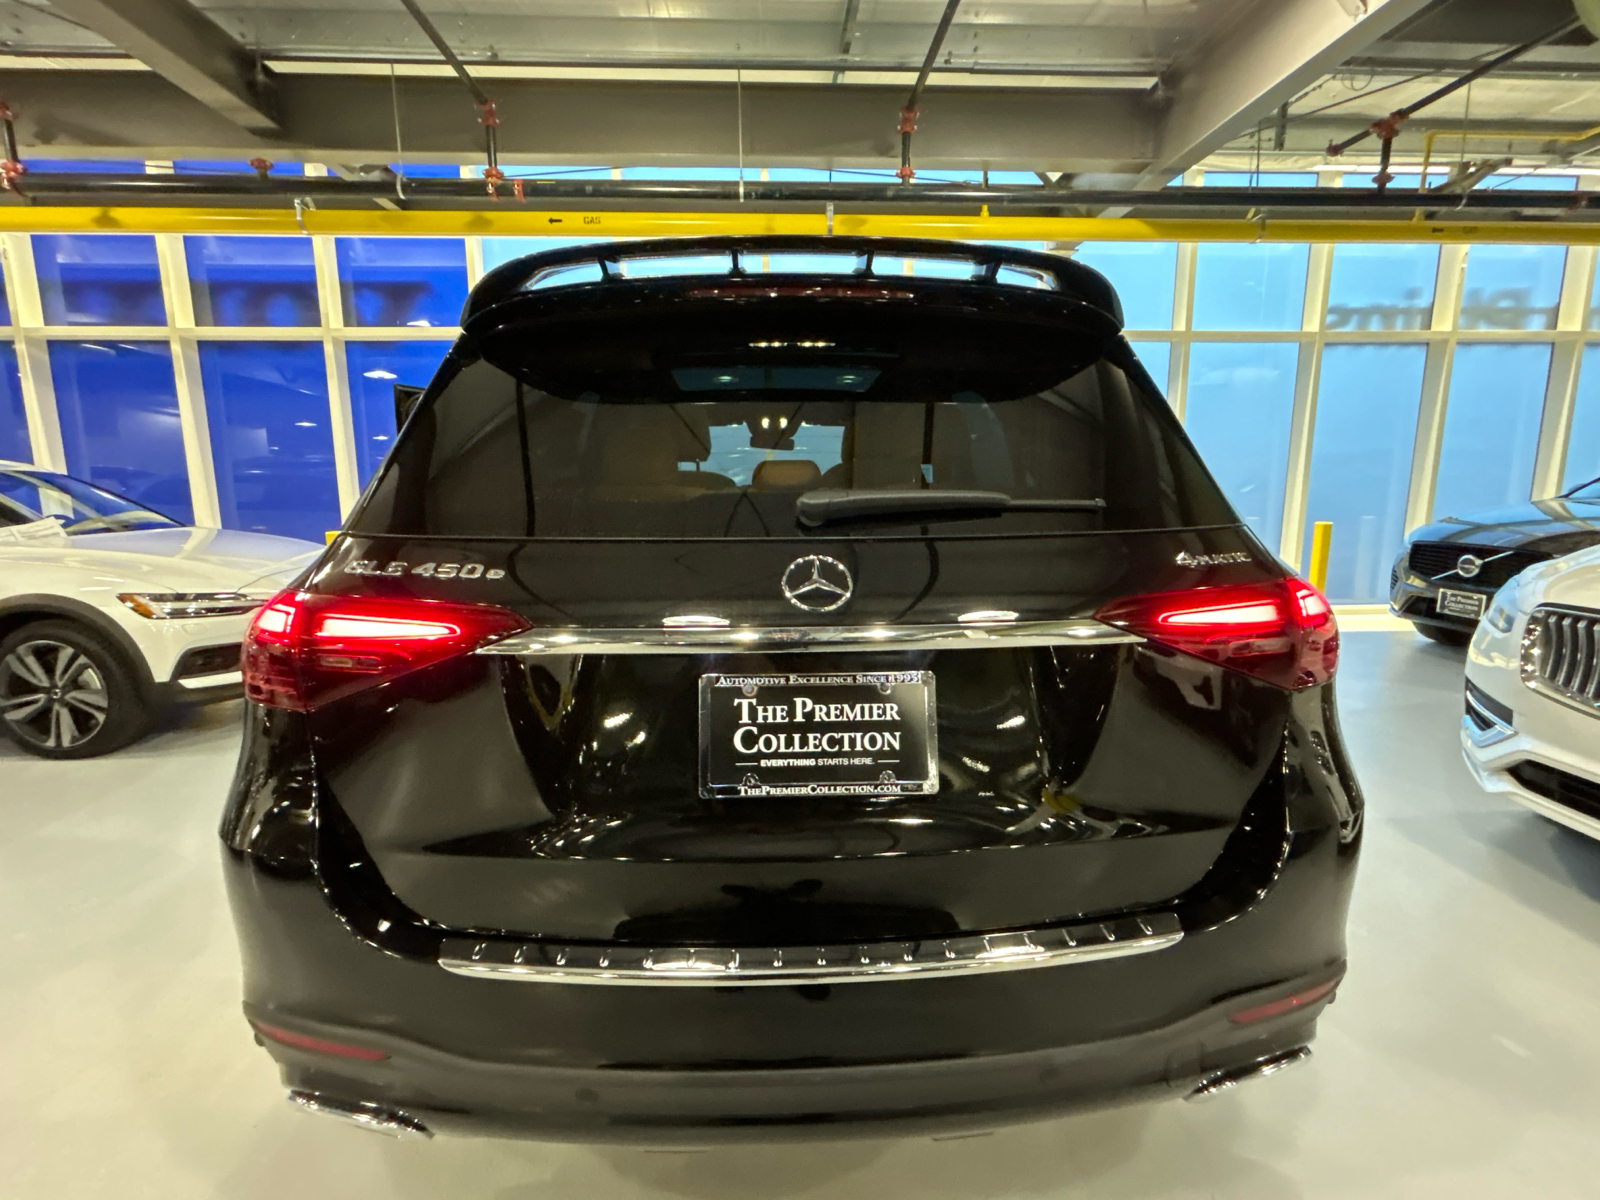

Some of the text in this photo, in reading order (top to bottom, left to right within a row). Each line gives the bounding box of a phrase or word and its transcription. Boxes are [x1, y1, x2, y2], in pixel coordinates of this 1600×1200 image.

[583, 216, 601, 225] GAS
[1175, 550, 1252, 568] 4MATIC
[1445, 601, 1479, 611] COLLECTION
[717, 675, 787, 686] AUTOMOTIVE
[788, 674, 853, 684] EXCELLENCE
[855, 674, 886, 684] SINCE
[733, 697, 901, 724] THE PREMIER
[733, 726, 902, 754] COLLECTION
[760, 757, 876, 767] EVERYTHING STARTS HERE.
[738, 784, 901, 796] THEPREMIERCOLLECTION.COM
